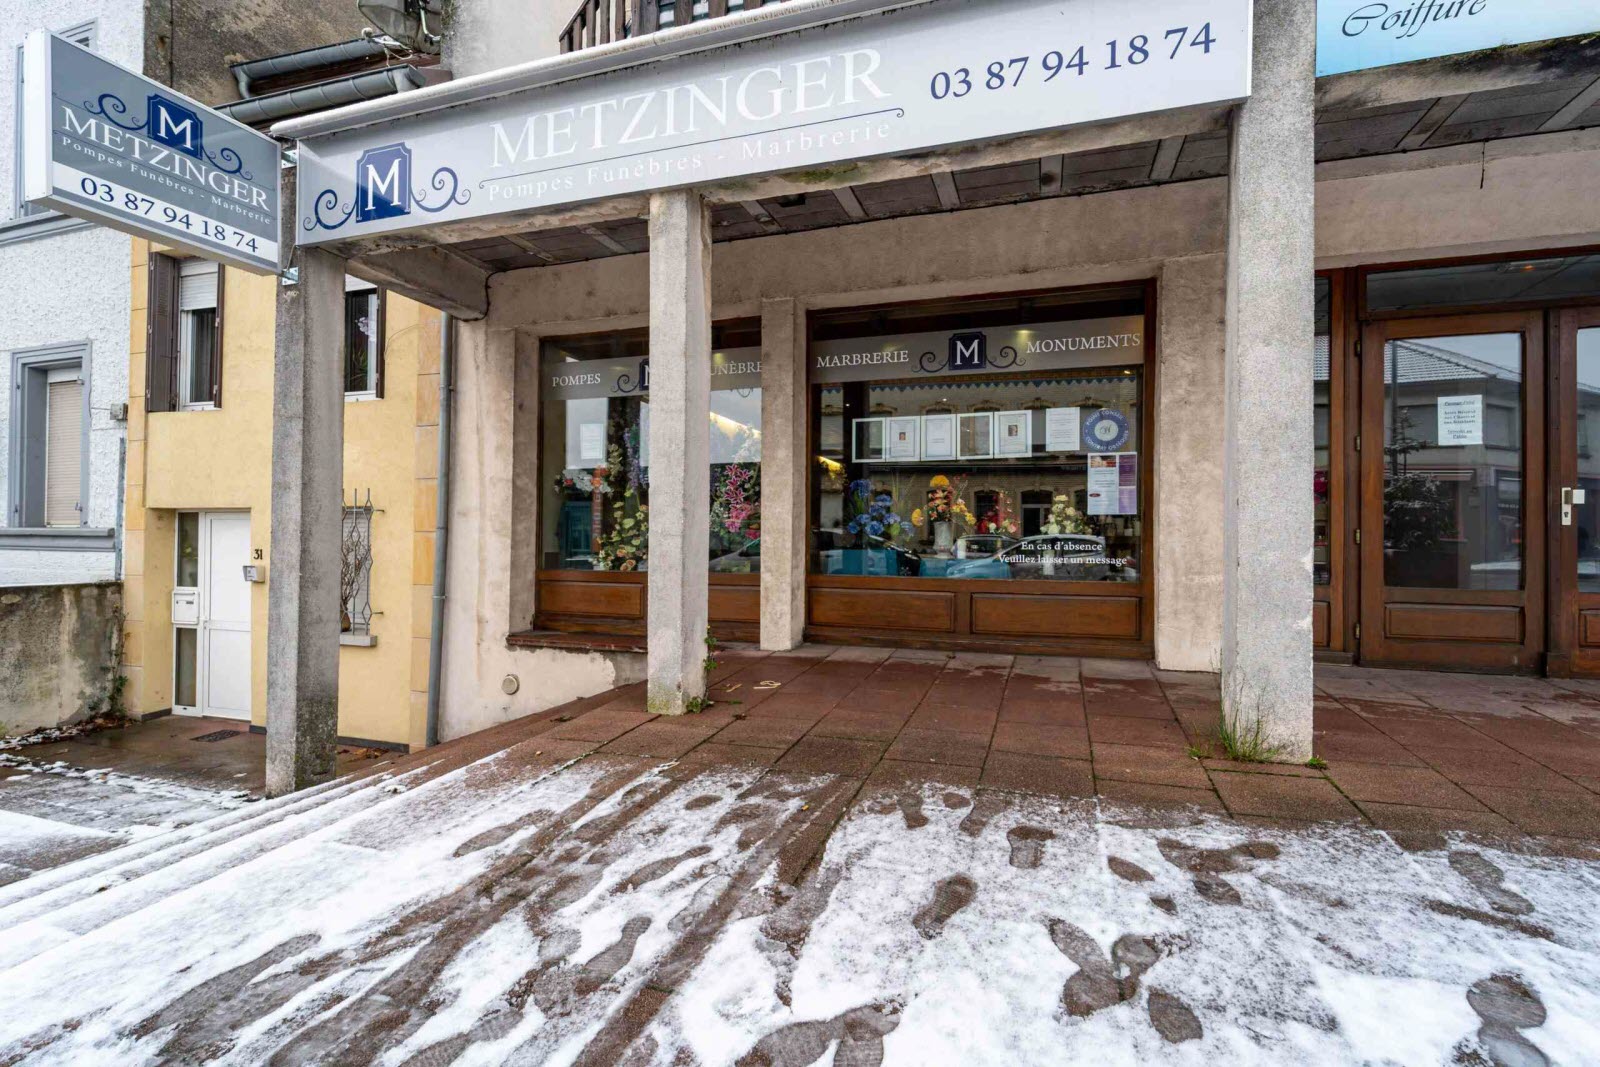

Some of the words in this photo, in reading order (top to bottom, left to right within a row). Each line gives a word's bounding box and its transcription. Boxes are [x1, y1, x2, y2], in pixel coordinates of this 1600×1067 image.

[1341, 0, 1487, 39] Coiffure
[930, 67, 972, 100] 03
[985, 56, 1029, 90] 87
[1041, 45, 1089, 82] 94
[1104, 34, 1150, 70] 18
[1164, 21, 1216, 60] 74
[157, 105, 194, 150] M
[490, 48, 893, 168] METZINGER
[61, 105, 271, 212] METZINGER
[62, 136, 123, 168] Pompes
[130, 163, 194, 195] Funèbres
[211, 195, 271, 225] Marbrerie
[488, 174, 574, 201] Pompes
[587, 153, 702, 185] Funèbres
[741, 120, 890, 160] Marbrerie
[364, 158, 402, 211] M
[81, 177, 115, 203] 03
[124, 193, 155, 215] 87
[163, 206, 193, 230] 94
[201, 220, 226, 241] 18
[233, 231, 259, 253] 74
[551, 373, 601, 387] POMPES
[711, 360, 762, 376] UNÈBRE
[816, 350, 909, 368] MARBRERIE
[954, 339, 980, 365] M
[1026, 333, 1141, 353] MONUMENTS
[253, 548, 263, 560] 31
[998, 553, 1035, 563] Veuillez
[1037, 554, 1068, 564] laisser
[1085, 556, 1128, 567] message
[1021, 541, 1034, 550] En
